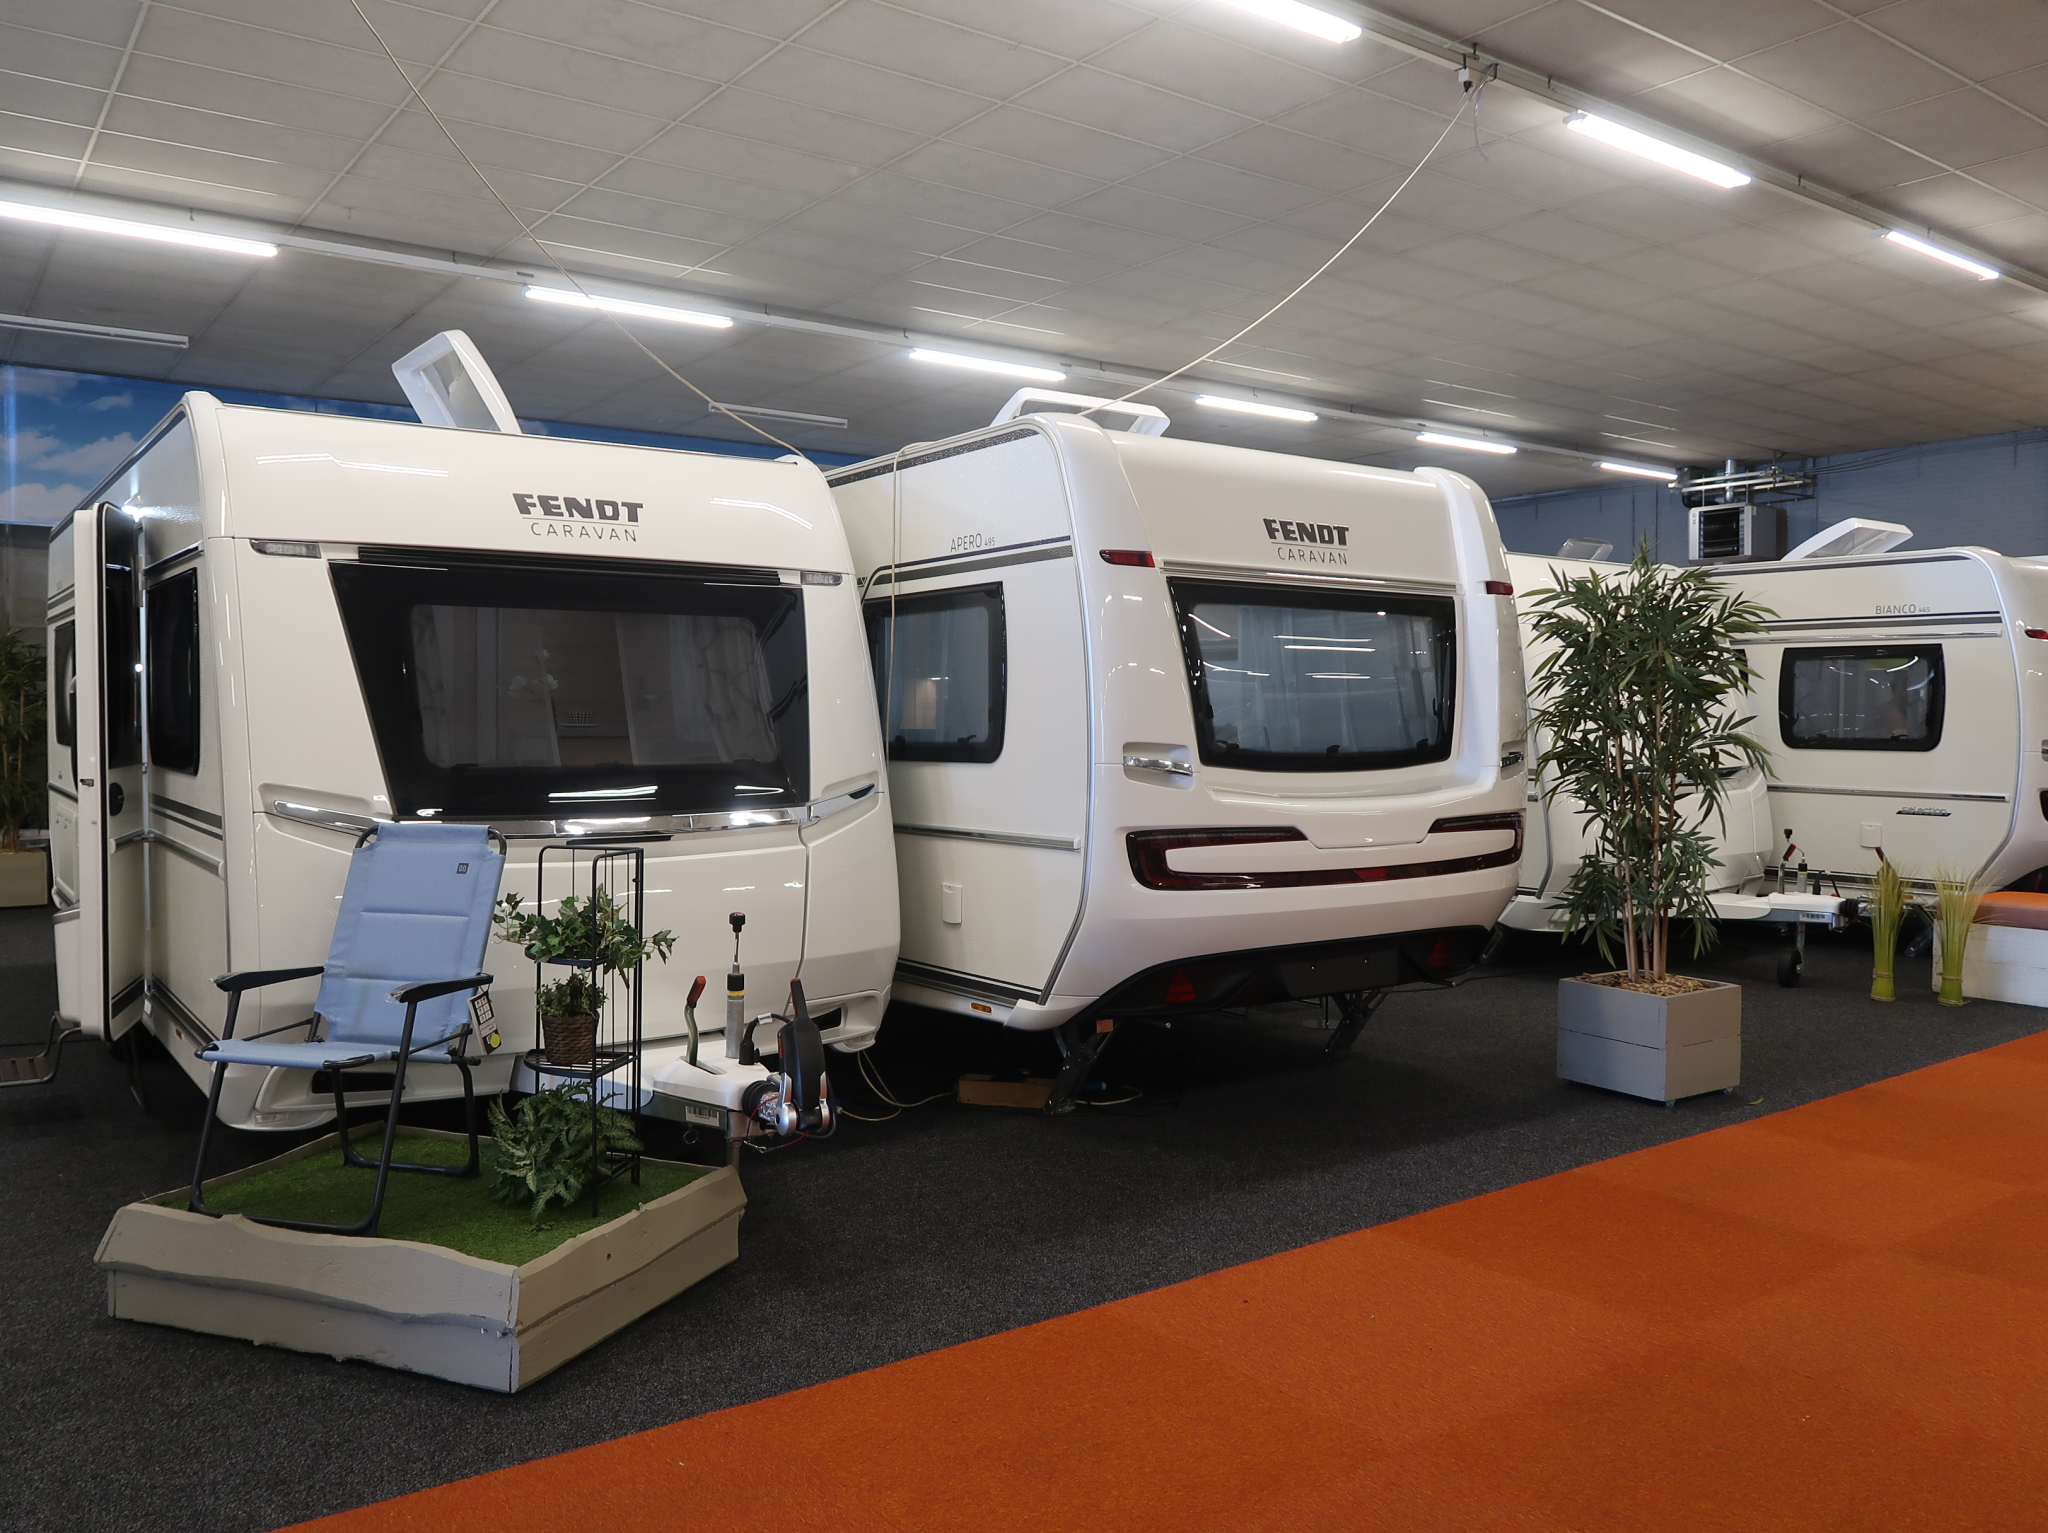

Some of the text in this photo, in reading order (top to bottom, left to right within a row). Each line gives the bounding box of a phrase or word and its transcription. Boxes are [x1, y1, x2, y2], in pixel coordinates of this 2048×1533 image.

[512, 493, 644, 523] FENDT
[530, 522, 637, 542] CARAVAN
[1262, 518, 1349, 546] FENDT
[950, 533, 996, 552] APERO 495
[1277, 547, 1348, 565] CARAVAN
[1875, 603, 1916, 615] BIANCO
